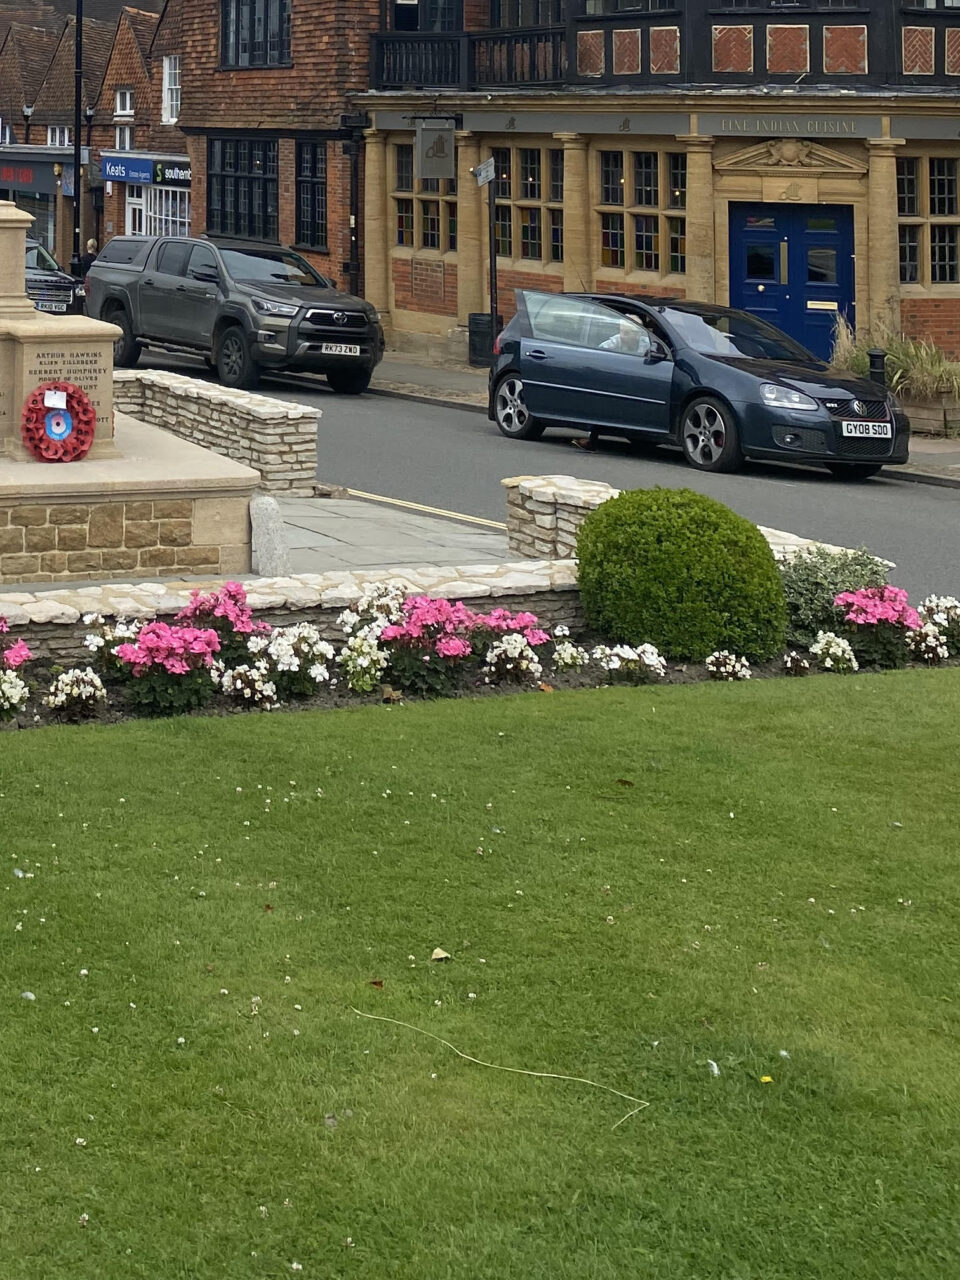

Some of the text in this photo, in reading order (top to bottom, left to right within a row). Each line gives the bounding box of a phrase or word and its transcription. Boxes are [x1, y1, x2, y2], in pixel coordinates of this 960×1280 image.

[722, 120, 857, 133] FINE INDIAN CUISINE
[106, 162, 126, 177] Keats
[324, 344, 342, 353] RK73
[846, 423, 870, 435] GY08
